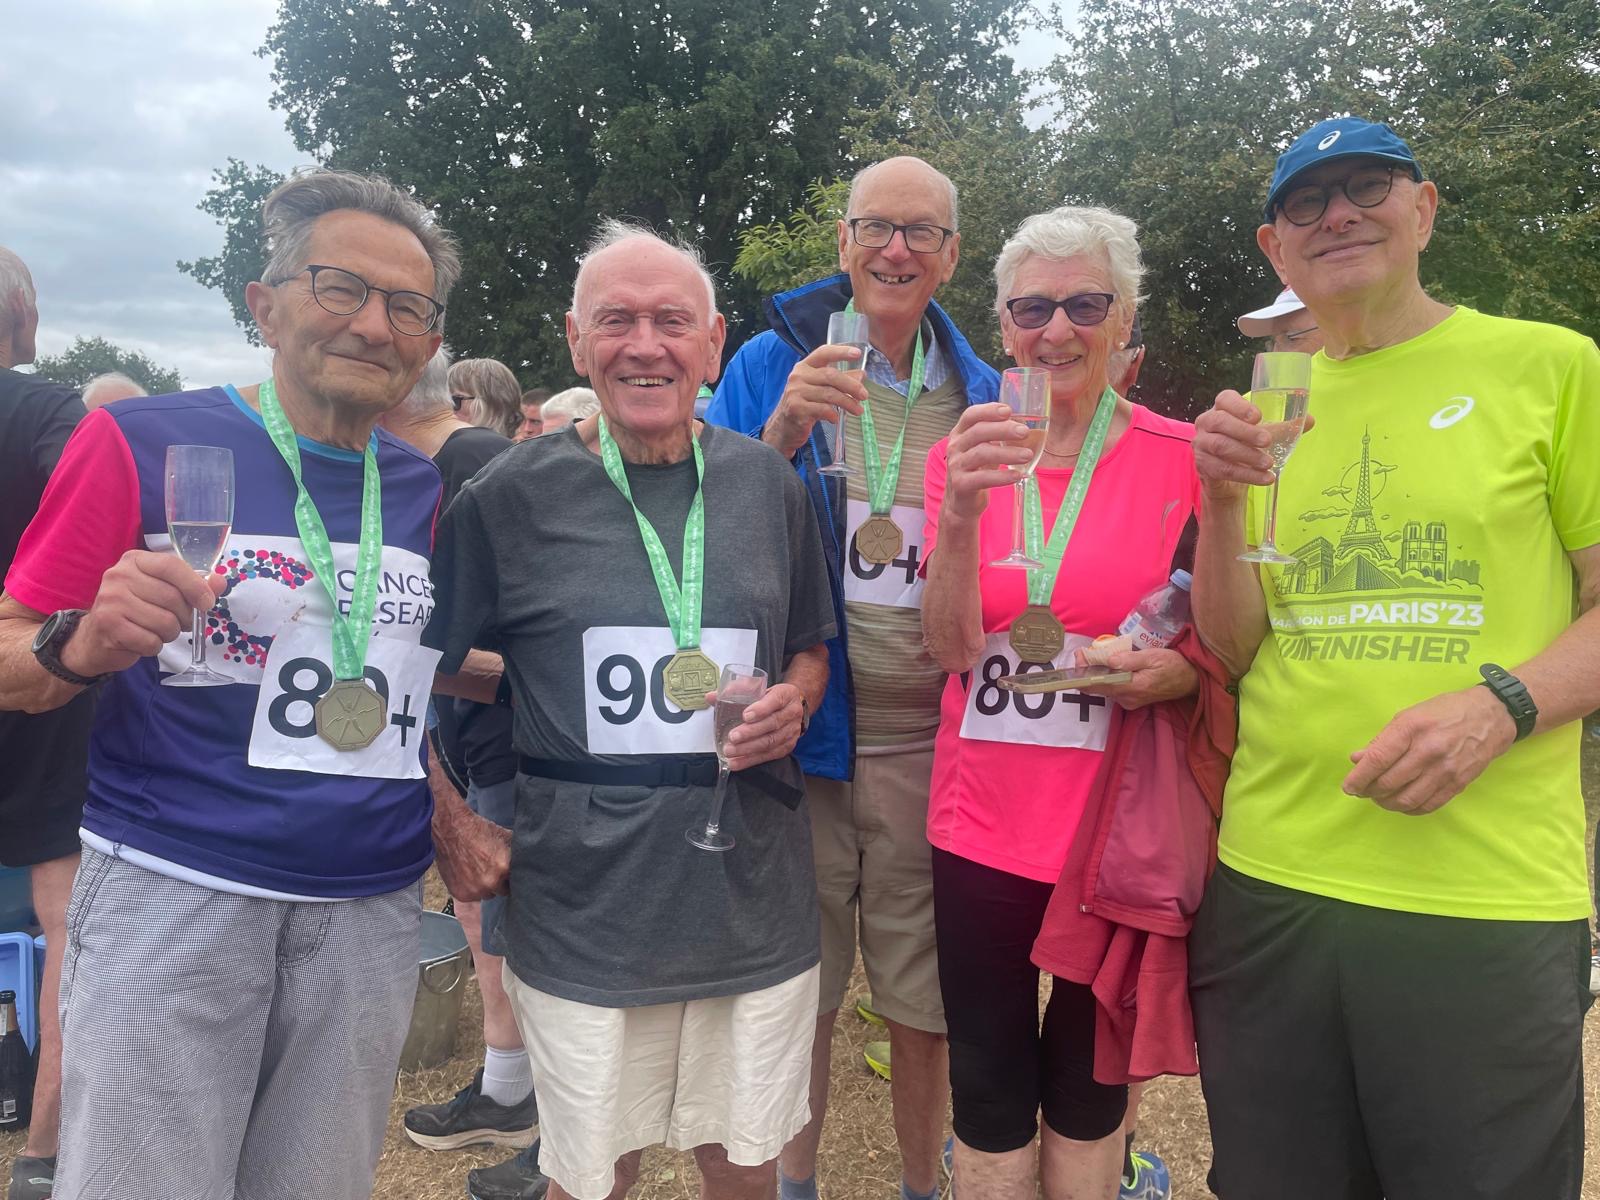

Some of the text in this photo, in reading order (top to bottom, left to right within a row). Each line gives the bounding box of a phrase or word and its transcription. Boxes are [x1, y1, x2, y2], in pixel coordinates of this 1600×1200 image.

[1327, 614, 1347, 626] DE
[1349, 601, 1485, 627] PARIS'23
[1139, 632, 1164, 648] evian
[1304, 635, 1471, 664] FINISHER
[975, 654, 1106, 723] 80+
